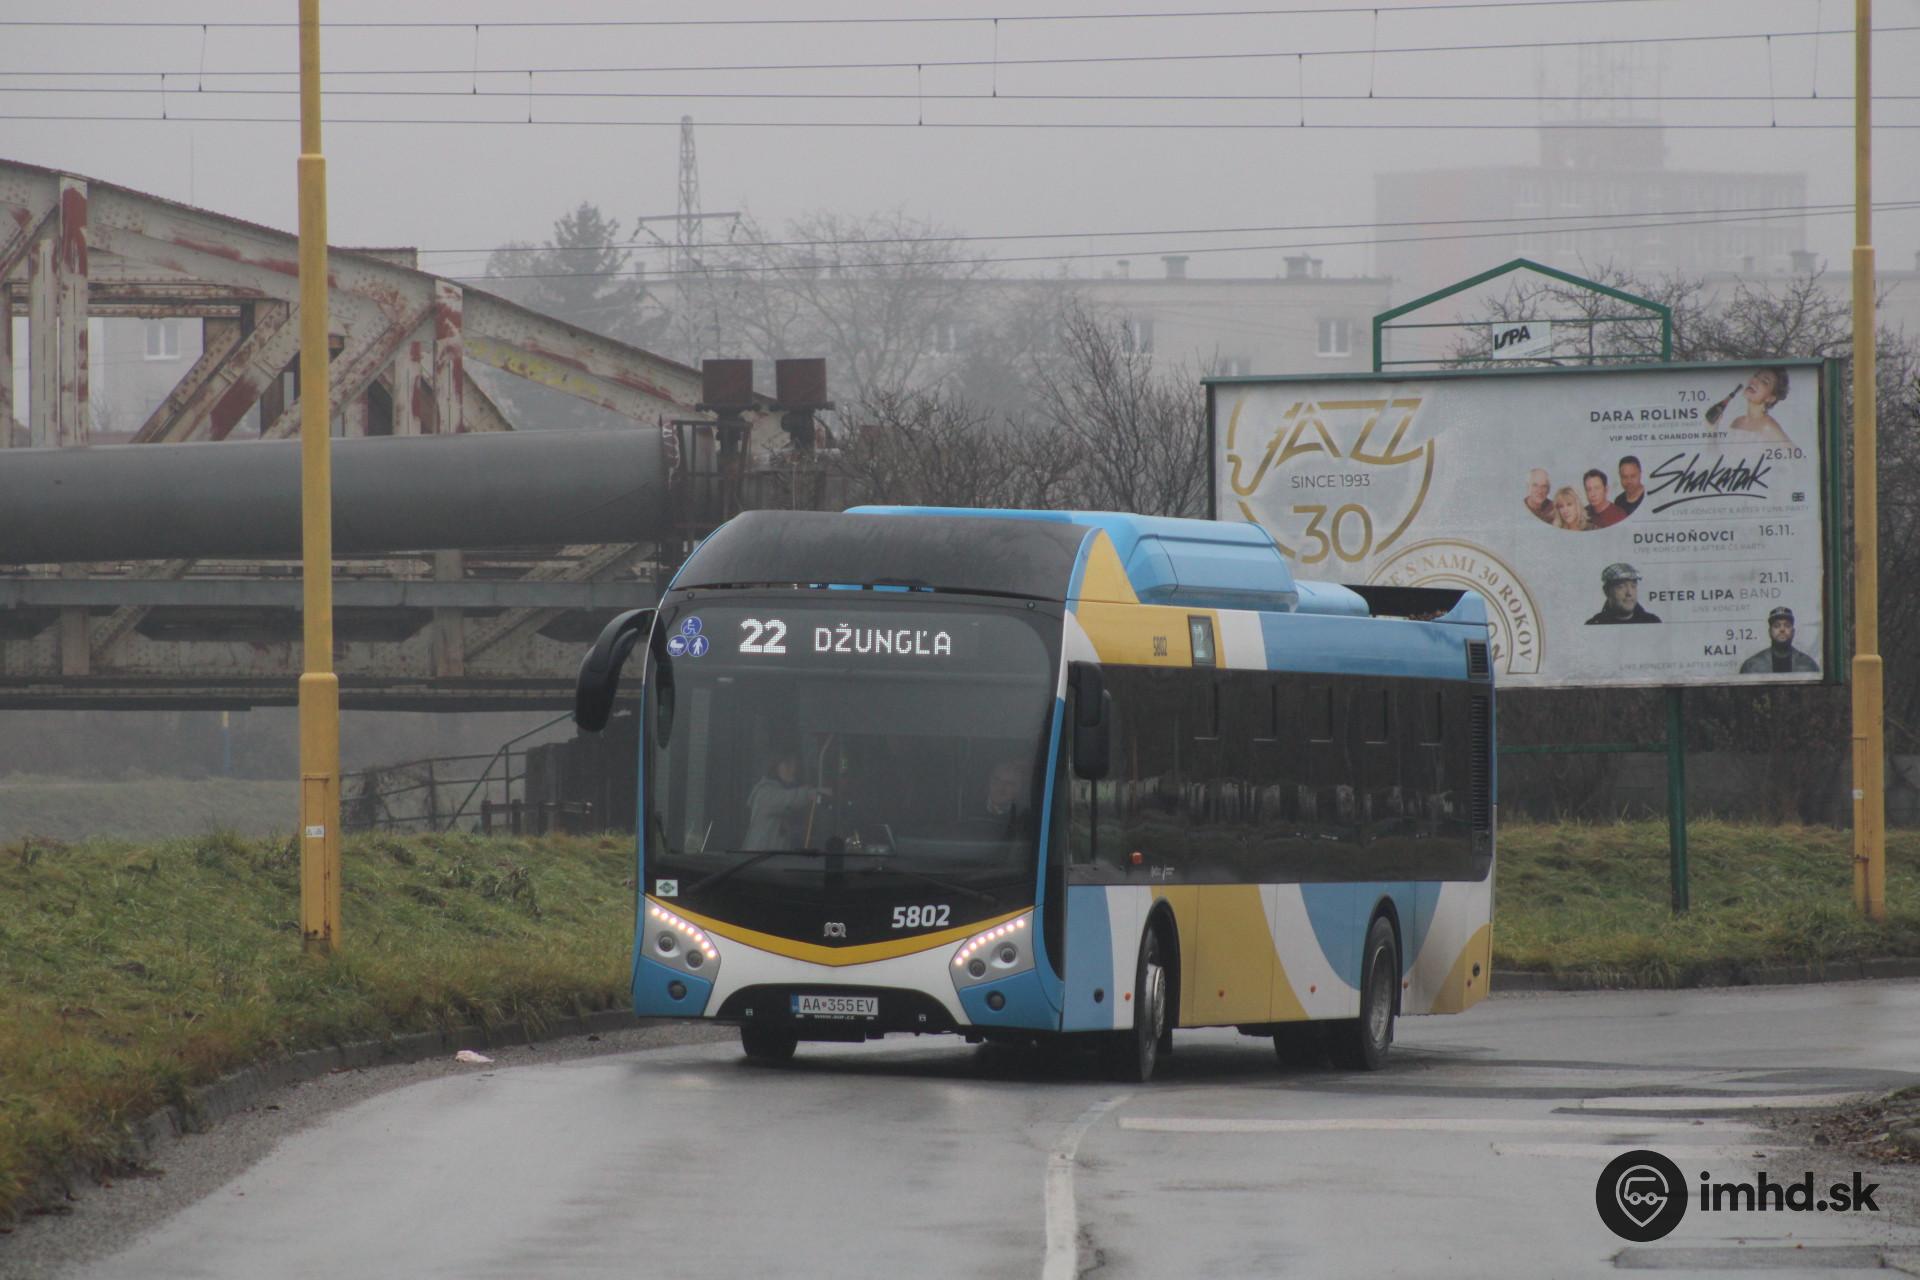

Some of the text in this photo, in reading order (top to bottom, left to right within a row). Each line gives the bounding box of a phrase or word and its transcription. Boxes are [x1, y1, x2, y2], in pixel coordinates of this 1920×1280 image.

[1678, 390, 1710, 402] 7.10.
[1590, 408, 1699, 423] DARA ROLINS
[1658, 432, 1699, 440] CHANDON
[1227, 398, 1423, 496] JAZZ
[1765, 448, 1807, 460] 26.10.
[1291, 474, 1371, 489] SINCE 1993
[1292, 503, 1373, 564] 30
[1633, 529, 1734, 544] DUCHOŇOVCI
[1759, 525, 1794, 536] 16.11.
[1759, 572, 1794, 584] 21.11.
[1649, 588, 1781, 601] PETER LIPA BAND
[1406, 563, 1417, 576] S
[1421, 554, 1476, 574] NAMI
[1478, 565, 1500, 587] 30
[1499, 584, 1532, 662] ROKOV
[739, 618, 951, 656] 22 DŽUNGĽA
[1726, 629, 1757, 641] 9.12.
[1704, 644, 1736, 656] KALI
[891, 904, 950, 929] 5802
